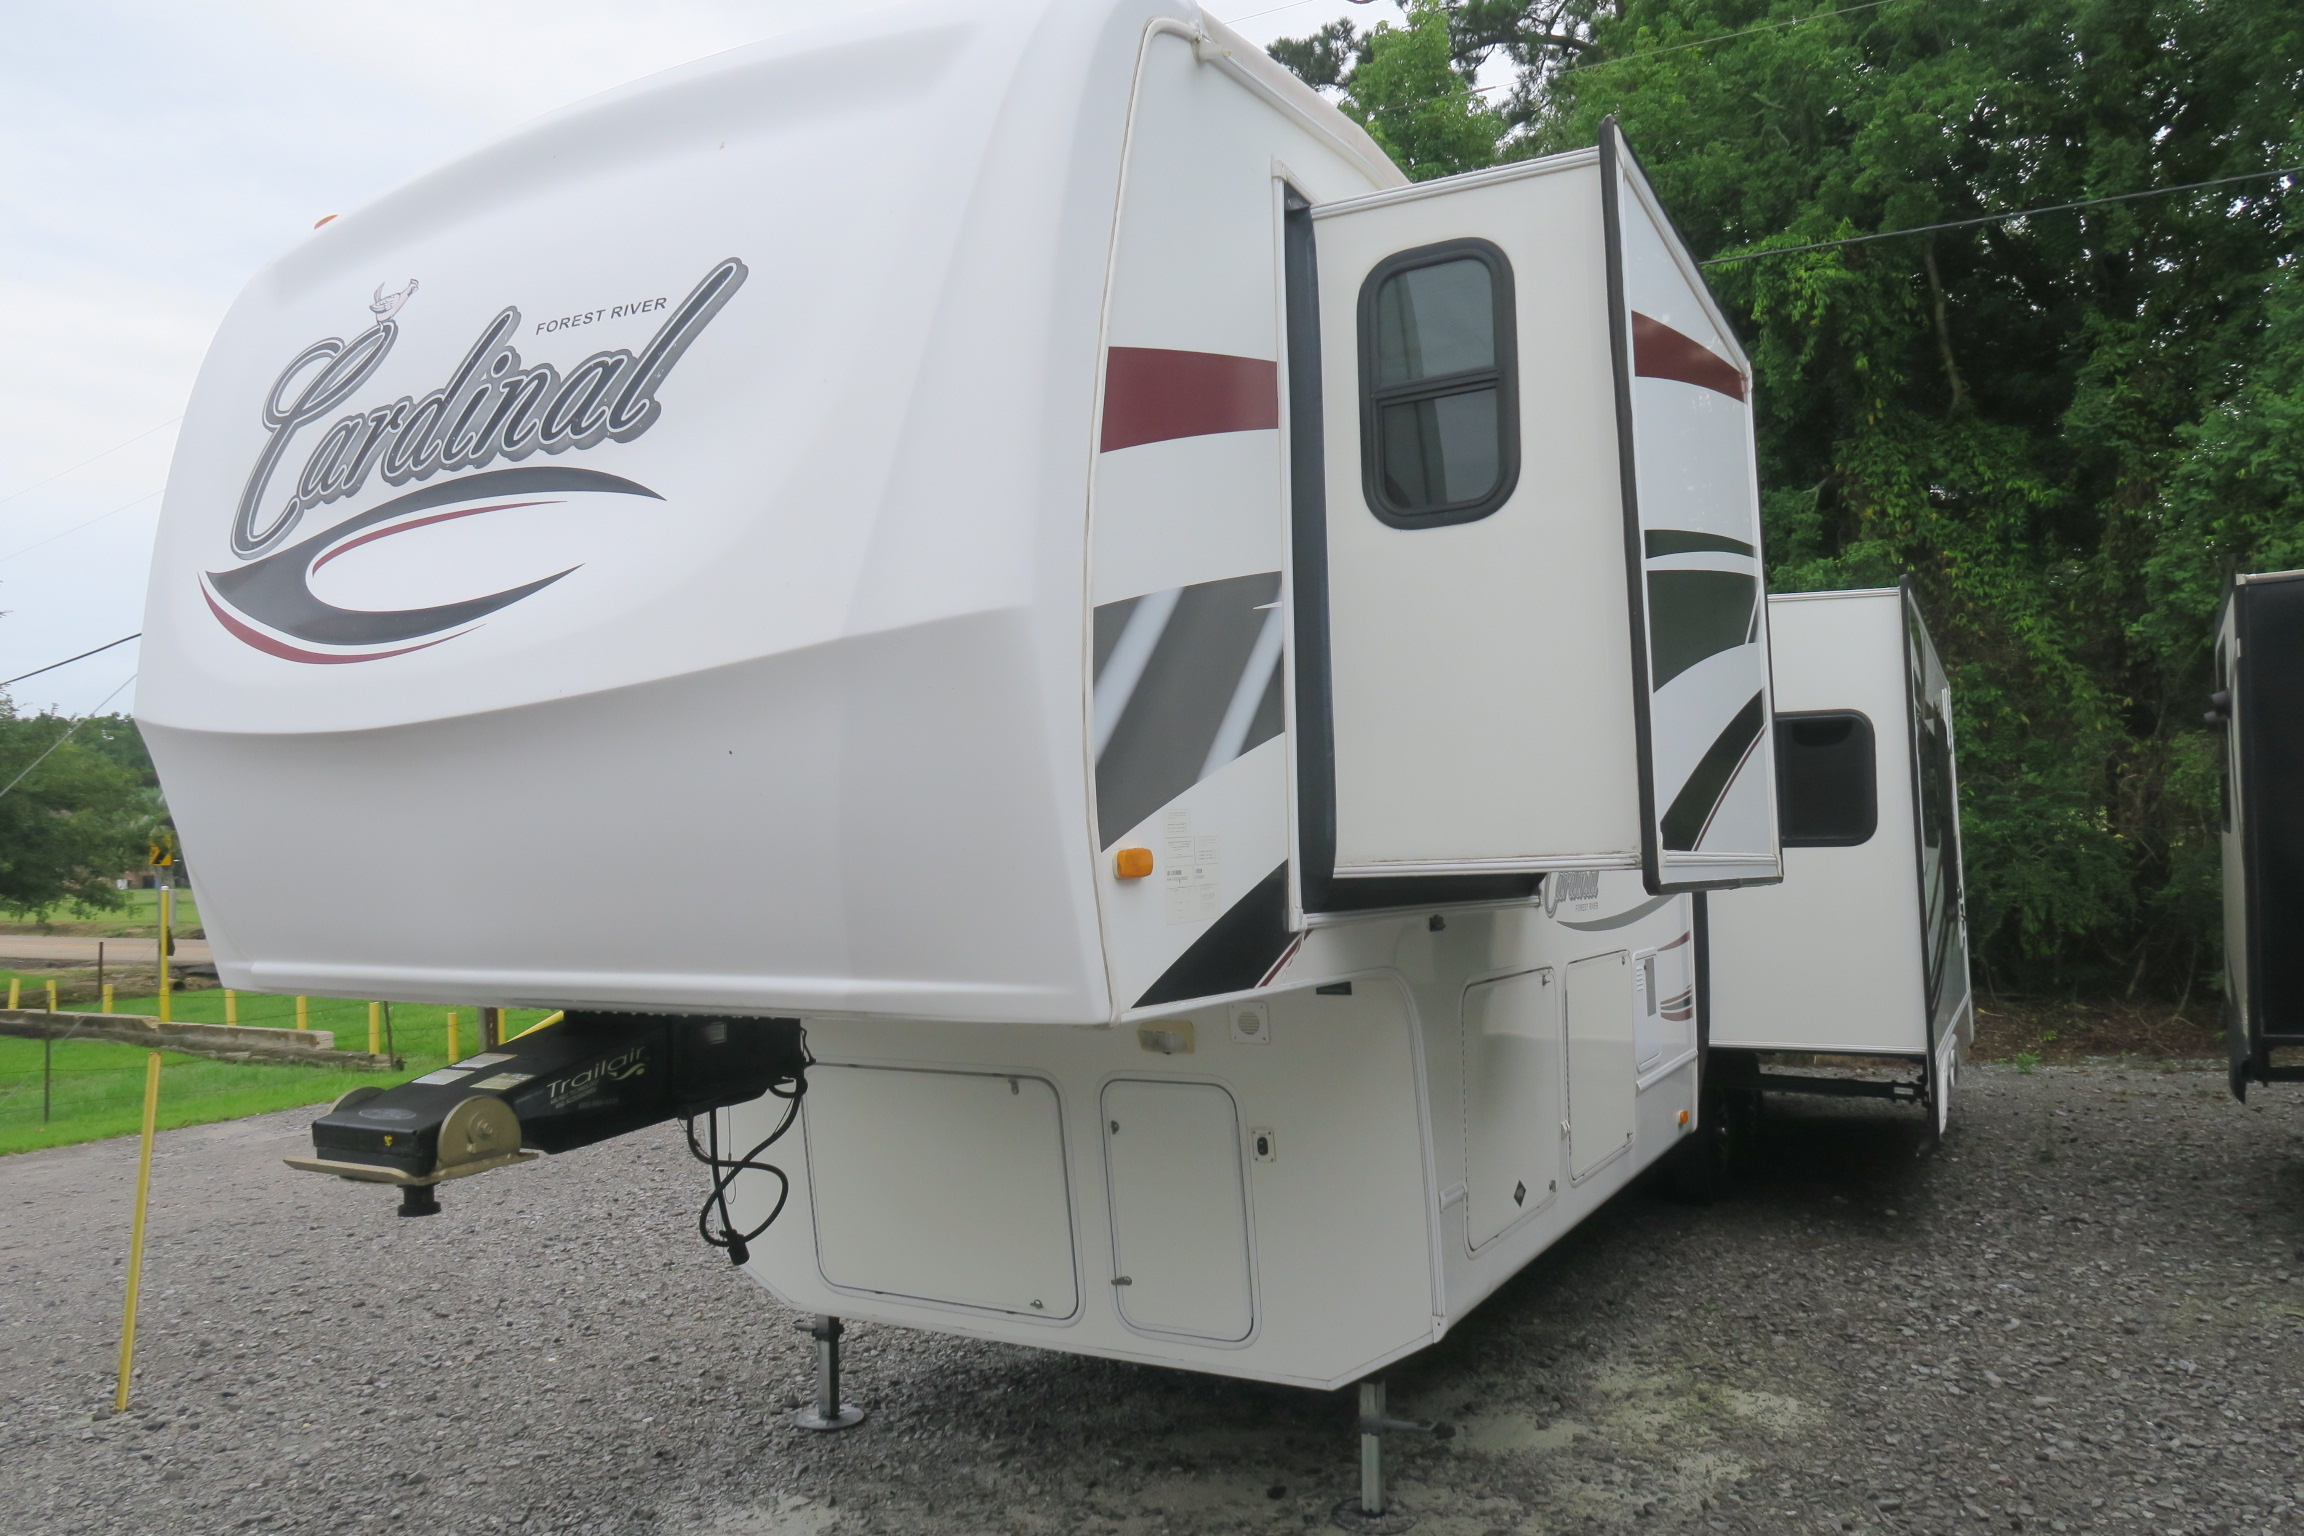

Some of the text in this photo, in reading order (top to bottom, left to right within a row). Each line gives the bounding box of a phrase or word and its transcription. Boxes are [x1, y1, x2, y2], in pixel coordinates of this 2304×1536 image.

[535, 297, 668, 336] FOREST RIVER
[231, 257, 749, 560] Cardinal
